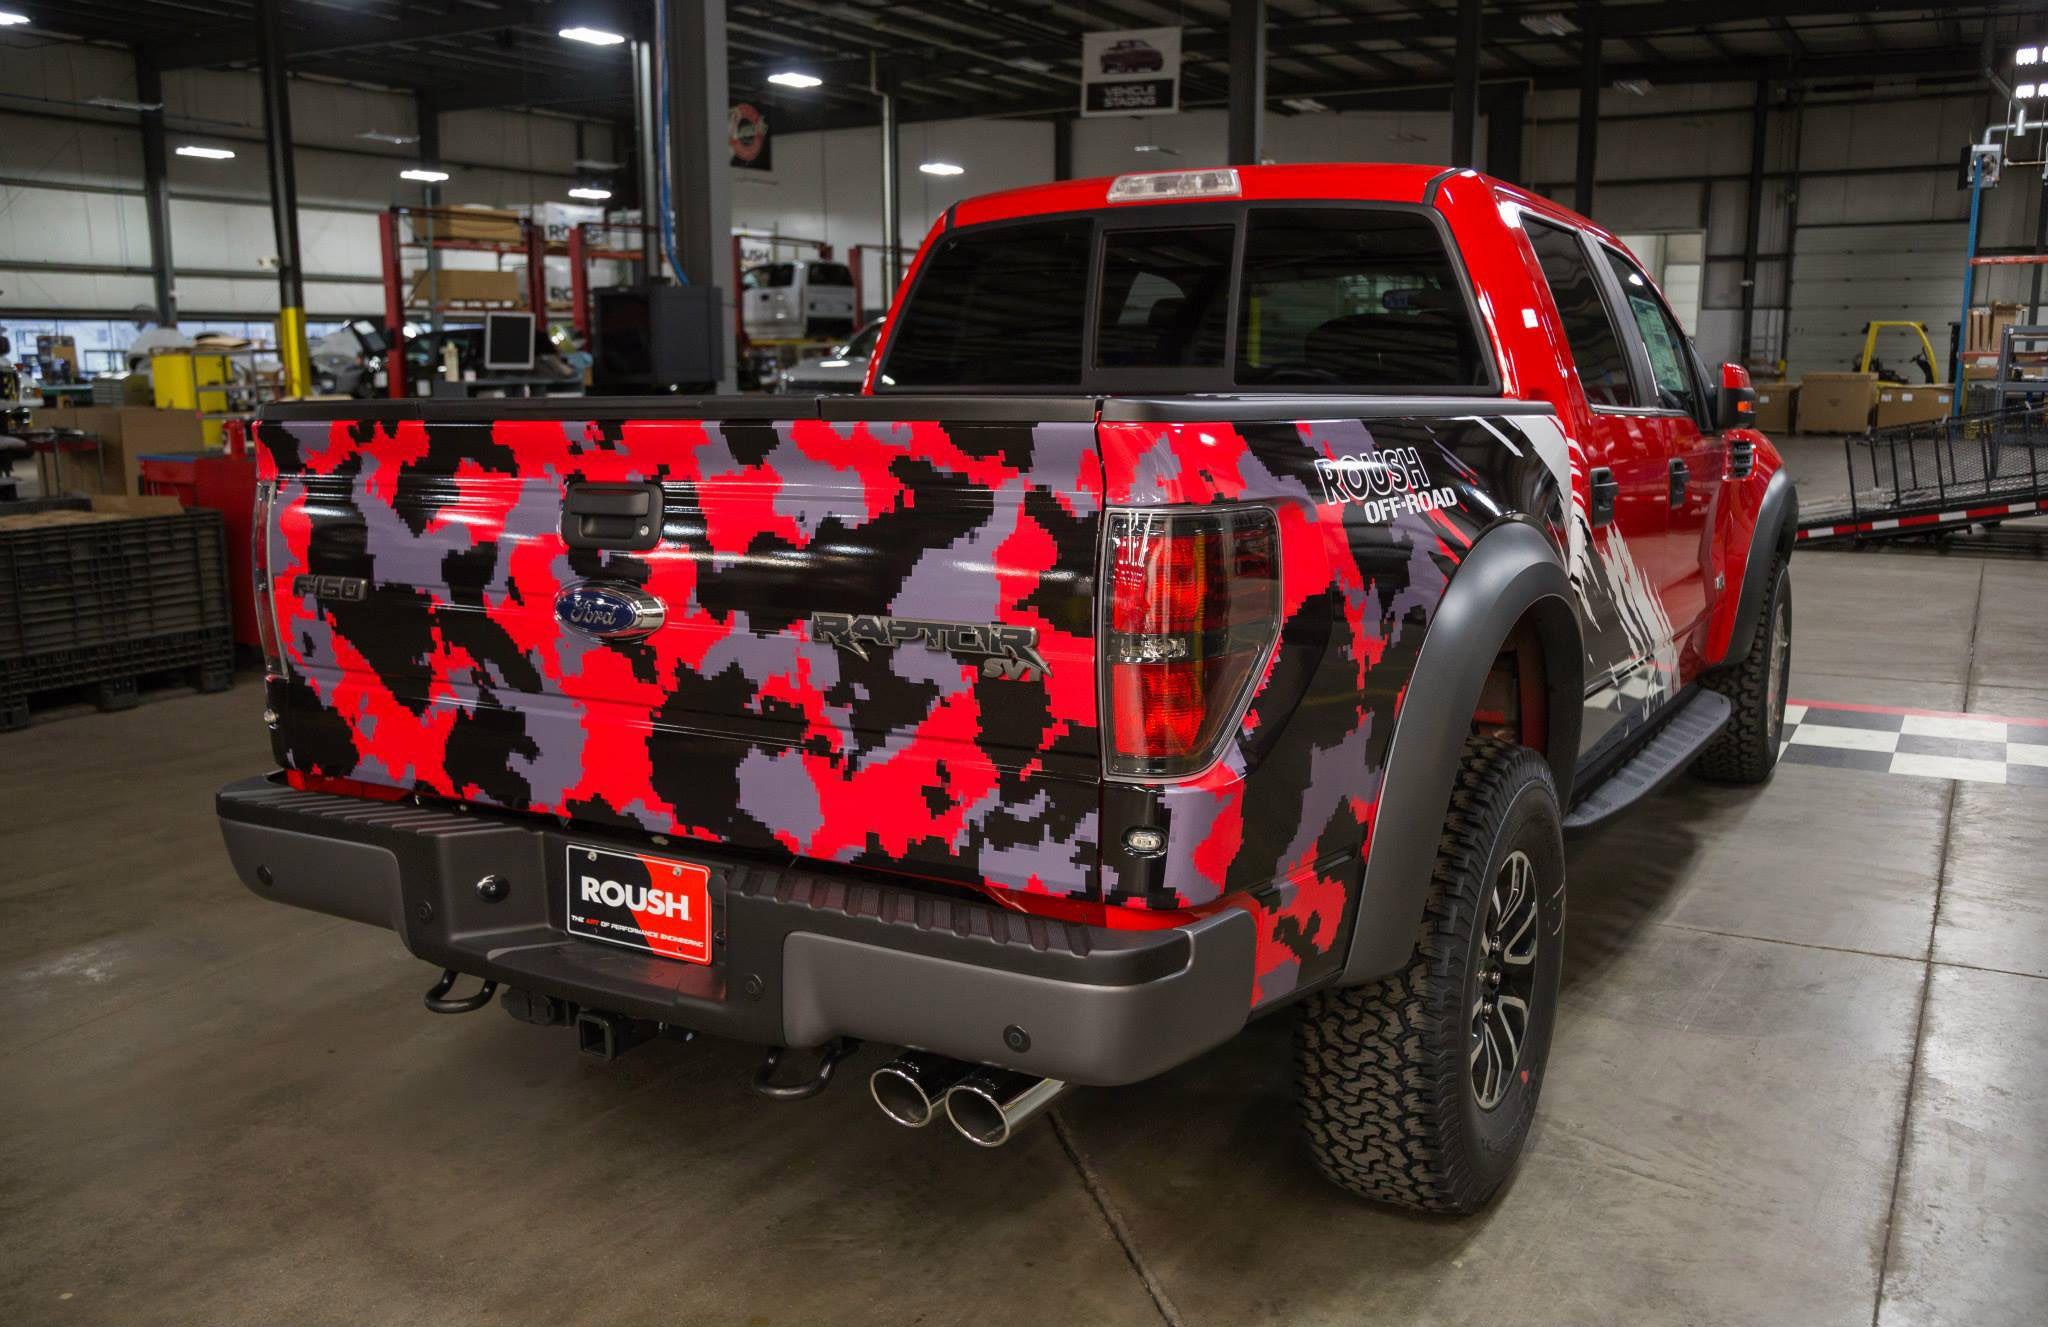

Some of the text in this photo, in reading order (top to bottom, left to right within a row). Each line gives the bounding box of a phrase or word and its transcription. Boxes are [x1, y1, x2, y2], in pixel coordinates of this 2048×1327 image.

[1103, 95, 1156, 108] STAGING
[1104, 84, 1156, 97] VEHICLE
[1314, 446, 1431, 505] ROUSH
[1364, 487, 1458, 524] OFF-ROAD
[570, 600, 620, 625] Ford
[812, 611, 1053, 677] RAPTOR
[982, 657, 1043, 681] SVT
[581, 876, 689, 921] ROUSH
[571, 914, 704, 949] THE ART OF PERFORMANCE ENGINEERING
